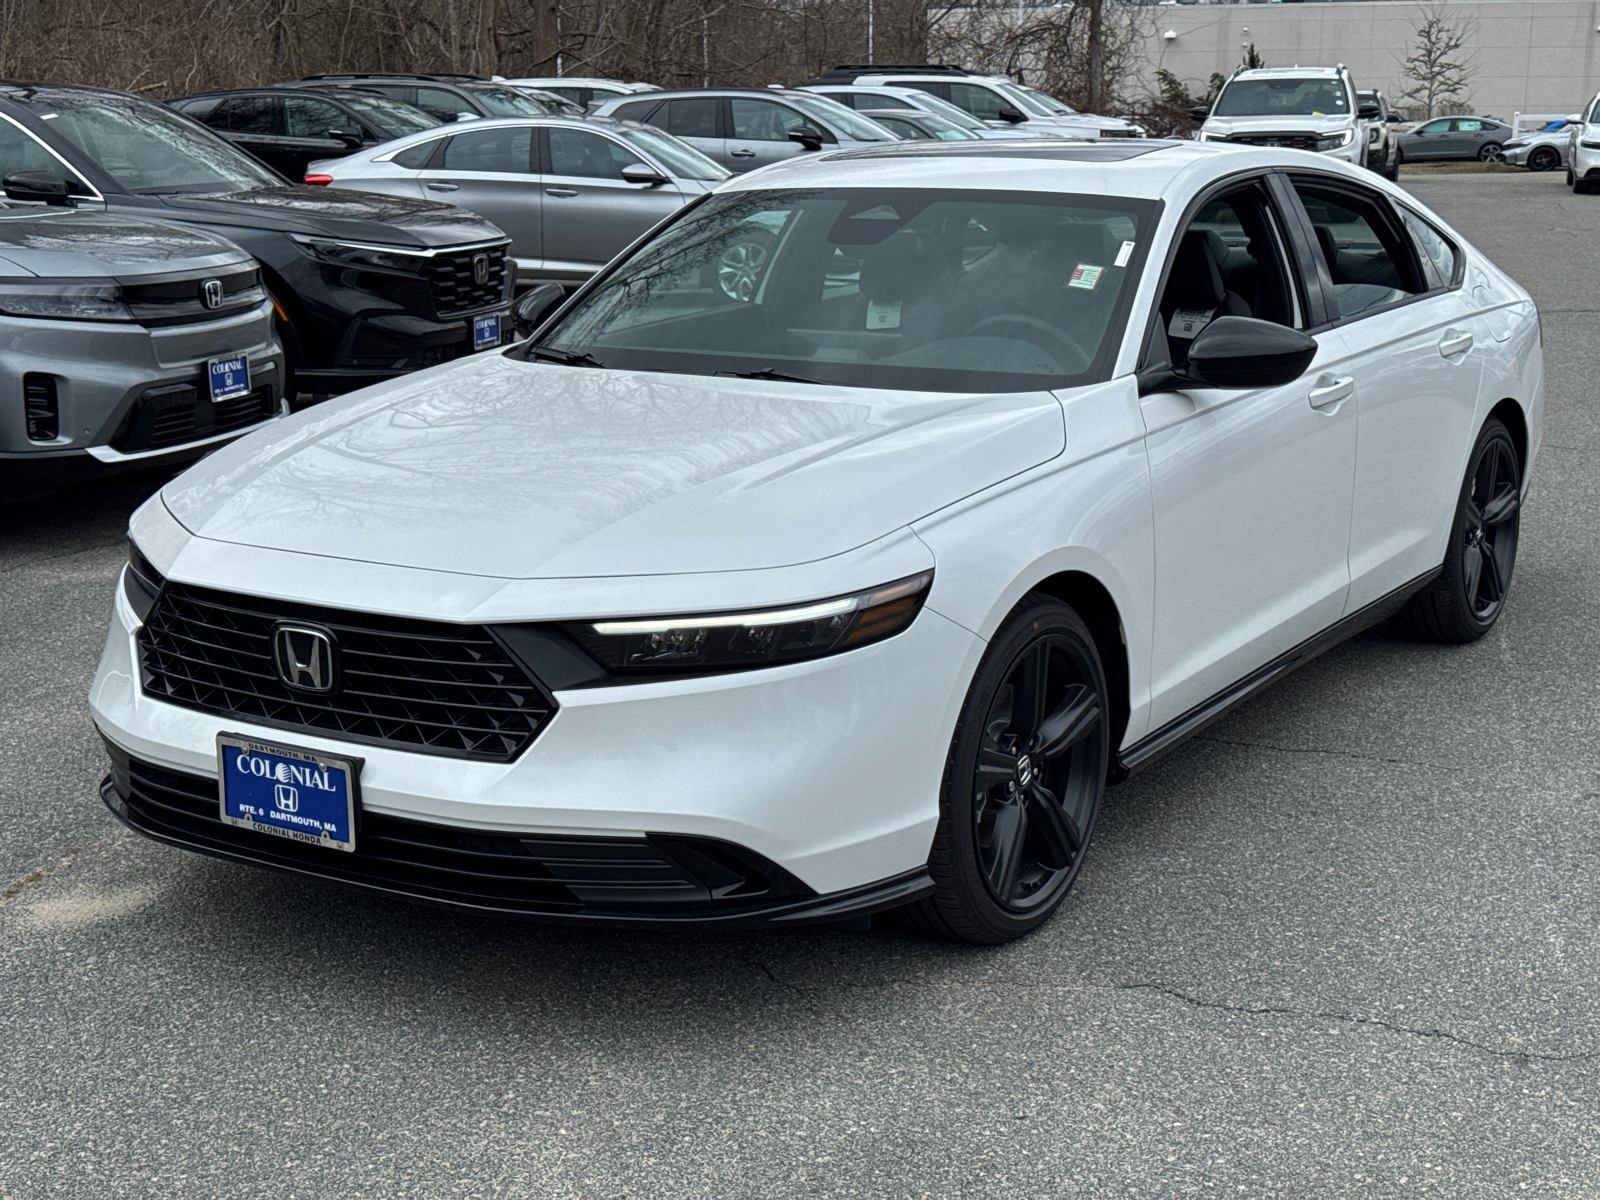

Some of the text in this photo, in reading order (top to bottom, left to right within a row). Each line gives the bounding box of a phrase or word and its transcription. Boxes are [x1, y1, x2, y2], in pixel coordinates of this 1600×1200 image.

[248, 743, 317, 763] DARTMOUTH, MA
[236, 754, 336, 792] COLONIAL
[239, 803, 337, 833] RTE. 6 DARTMOUTH, MA
[252, 822, 322, 845] COLONIAL HONDA
